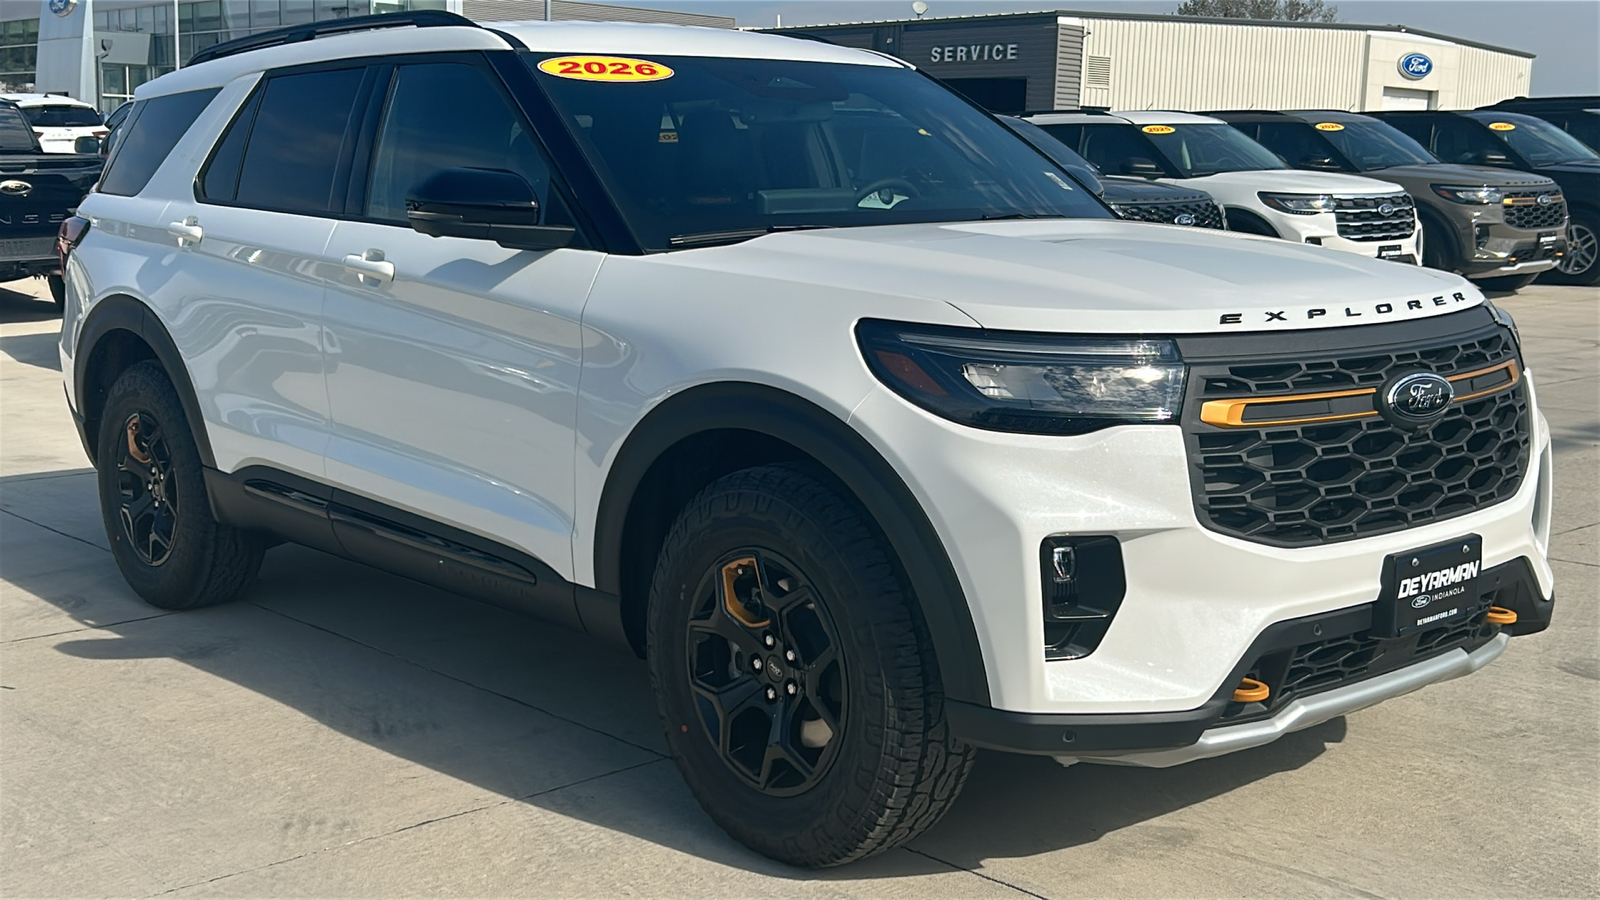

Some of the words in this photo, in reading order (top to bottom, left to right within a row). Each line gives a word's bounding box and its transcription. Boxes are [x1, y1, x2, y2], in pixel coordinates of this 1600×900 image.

[930, 44, 1018, 62] SERVICE
[558, 61, 658, 76] 2026
[1219, 292, 1466, 325] EXPLORER
[1409, 383, 1443, 410] Ford
[1398, 560, 1479, 599] DEYARMAN
[1431, 586, 1465, 602] INDIANOLA
